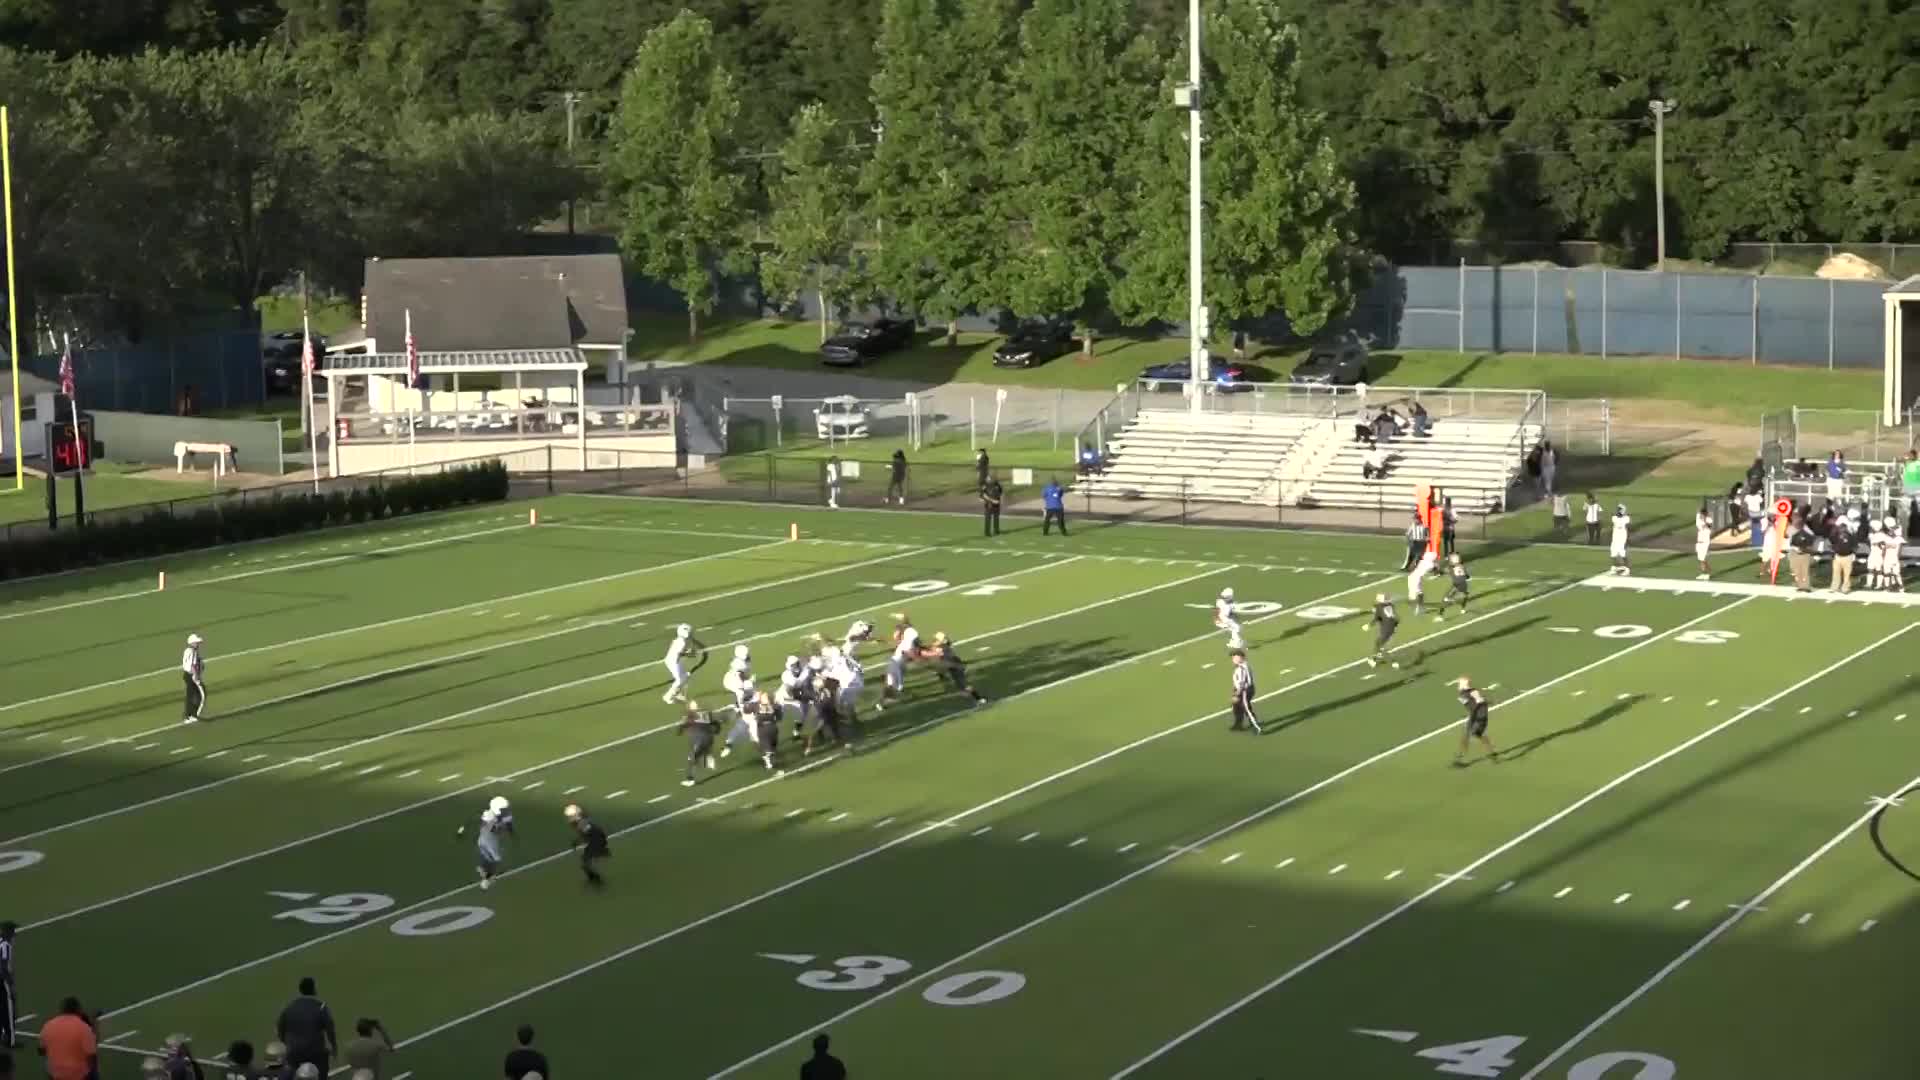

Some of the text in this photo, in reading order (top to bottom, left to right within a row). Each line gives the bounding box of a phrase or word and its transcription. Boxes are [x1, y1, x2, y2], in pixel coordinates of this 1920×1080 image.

[272, 892, 495, 936] 20
[796, 955, 1026, 1005] 30
[1415, 1035, 1676, 1080] 40
